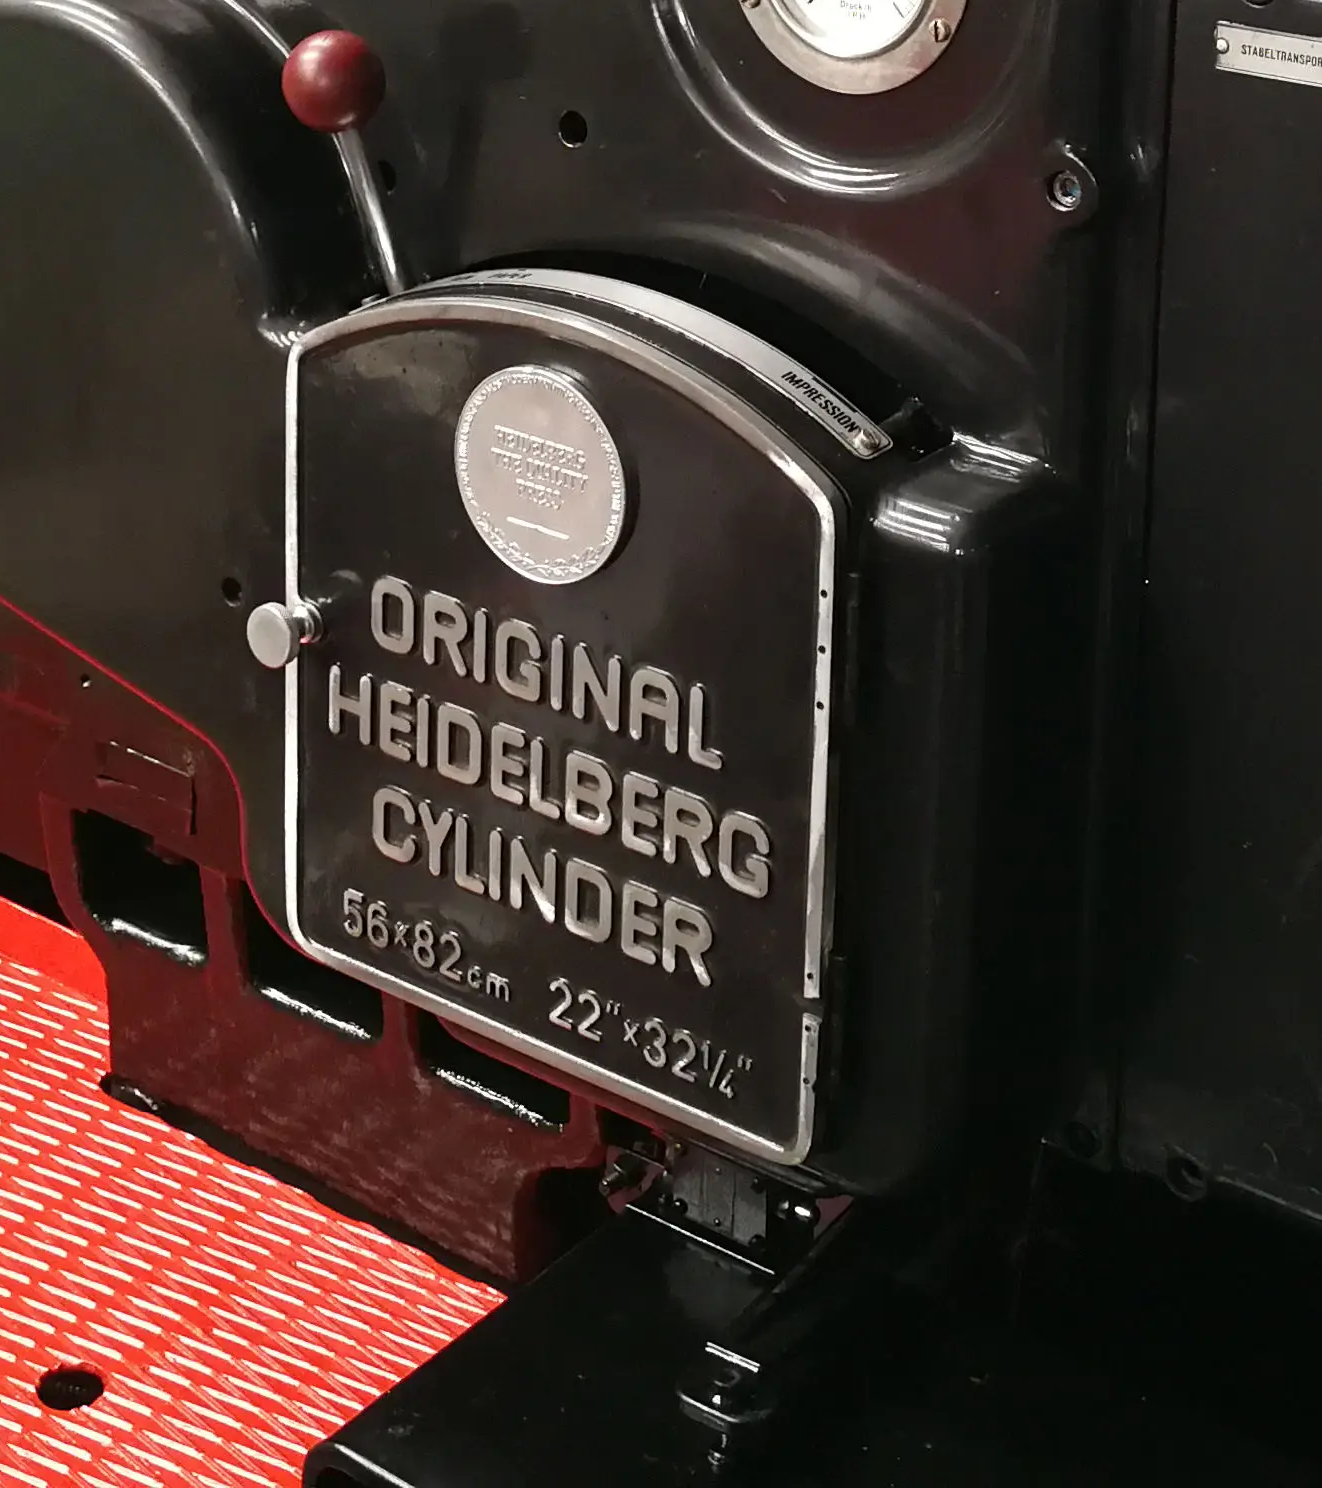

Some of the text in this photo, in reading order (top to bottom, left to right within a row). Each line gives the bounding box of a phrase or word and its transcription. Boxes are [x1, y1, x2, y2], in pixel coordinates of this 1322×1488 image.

[781, 370, 860, 434] IMPRESSION
[371, 574, 724, 771] ORIGINAL
[329, 665, 773, 899] HEIDELBERG
[372, 785, 714, 988] CYLINDER
